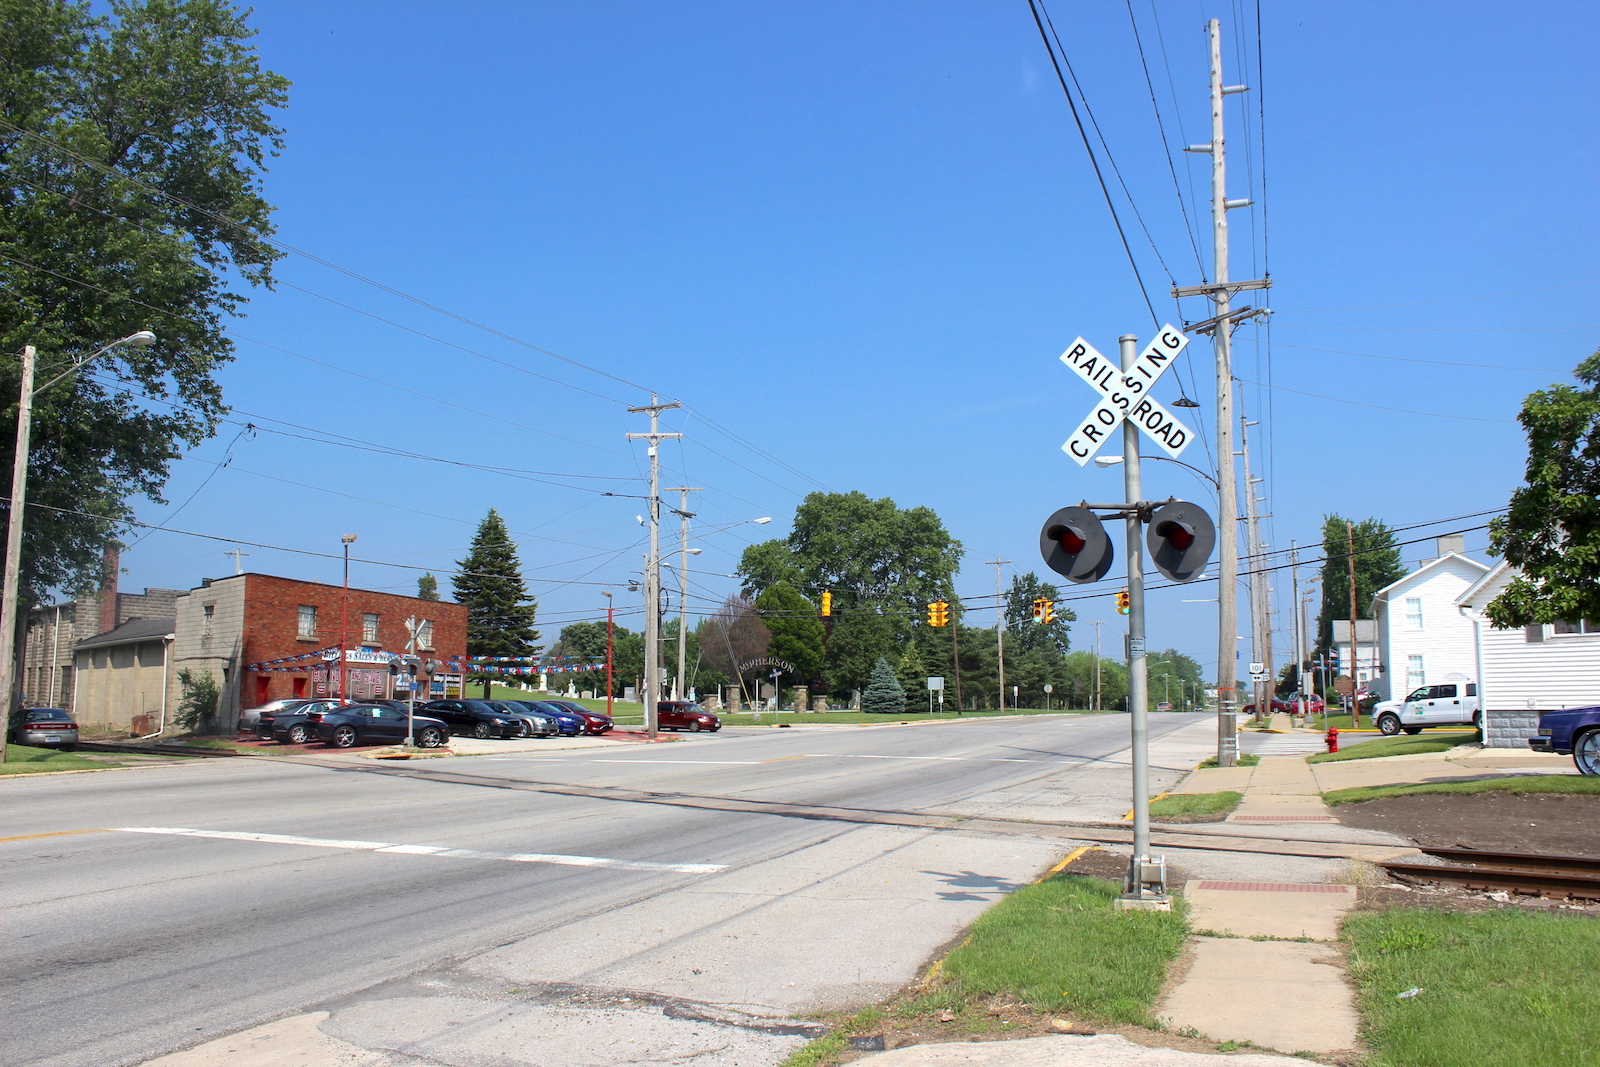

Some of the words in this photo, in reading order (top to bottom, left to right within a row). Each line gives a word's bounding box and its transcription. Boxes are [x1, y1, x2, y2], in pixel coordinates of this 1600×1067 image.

[1067, 343, 1113, 392] RAIL
[1132, 400, 1186, 449] ROAD
[1070, 332, 1180, 458] CROSSING
[313, 669, 328, 682] BUY
